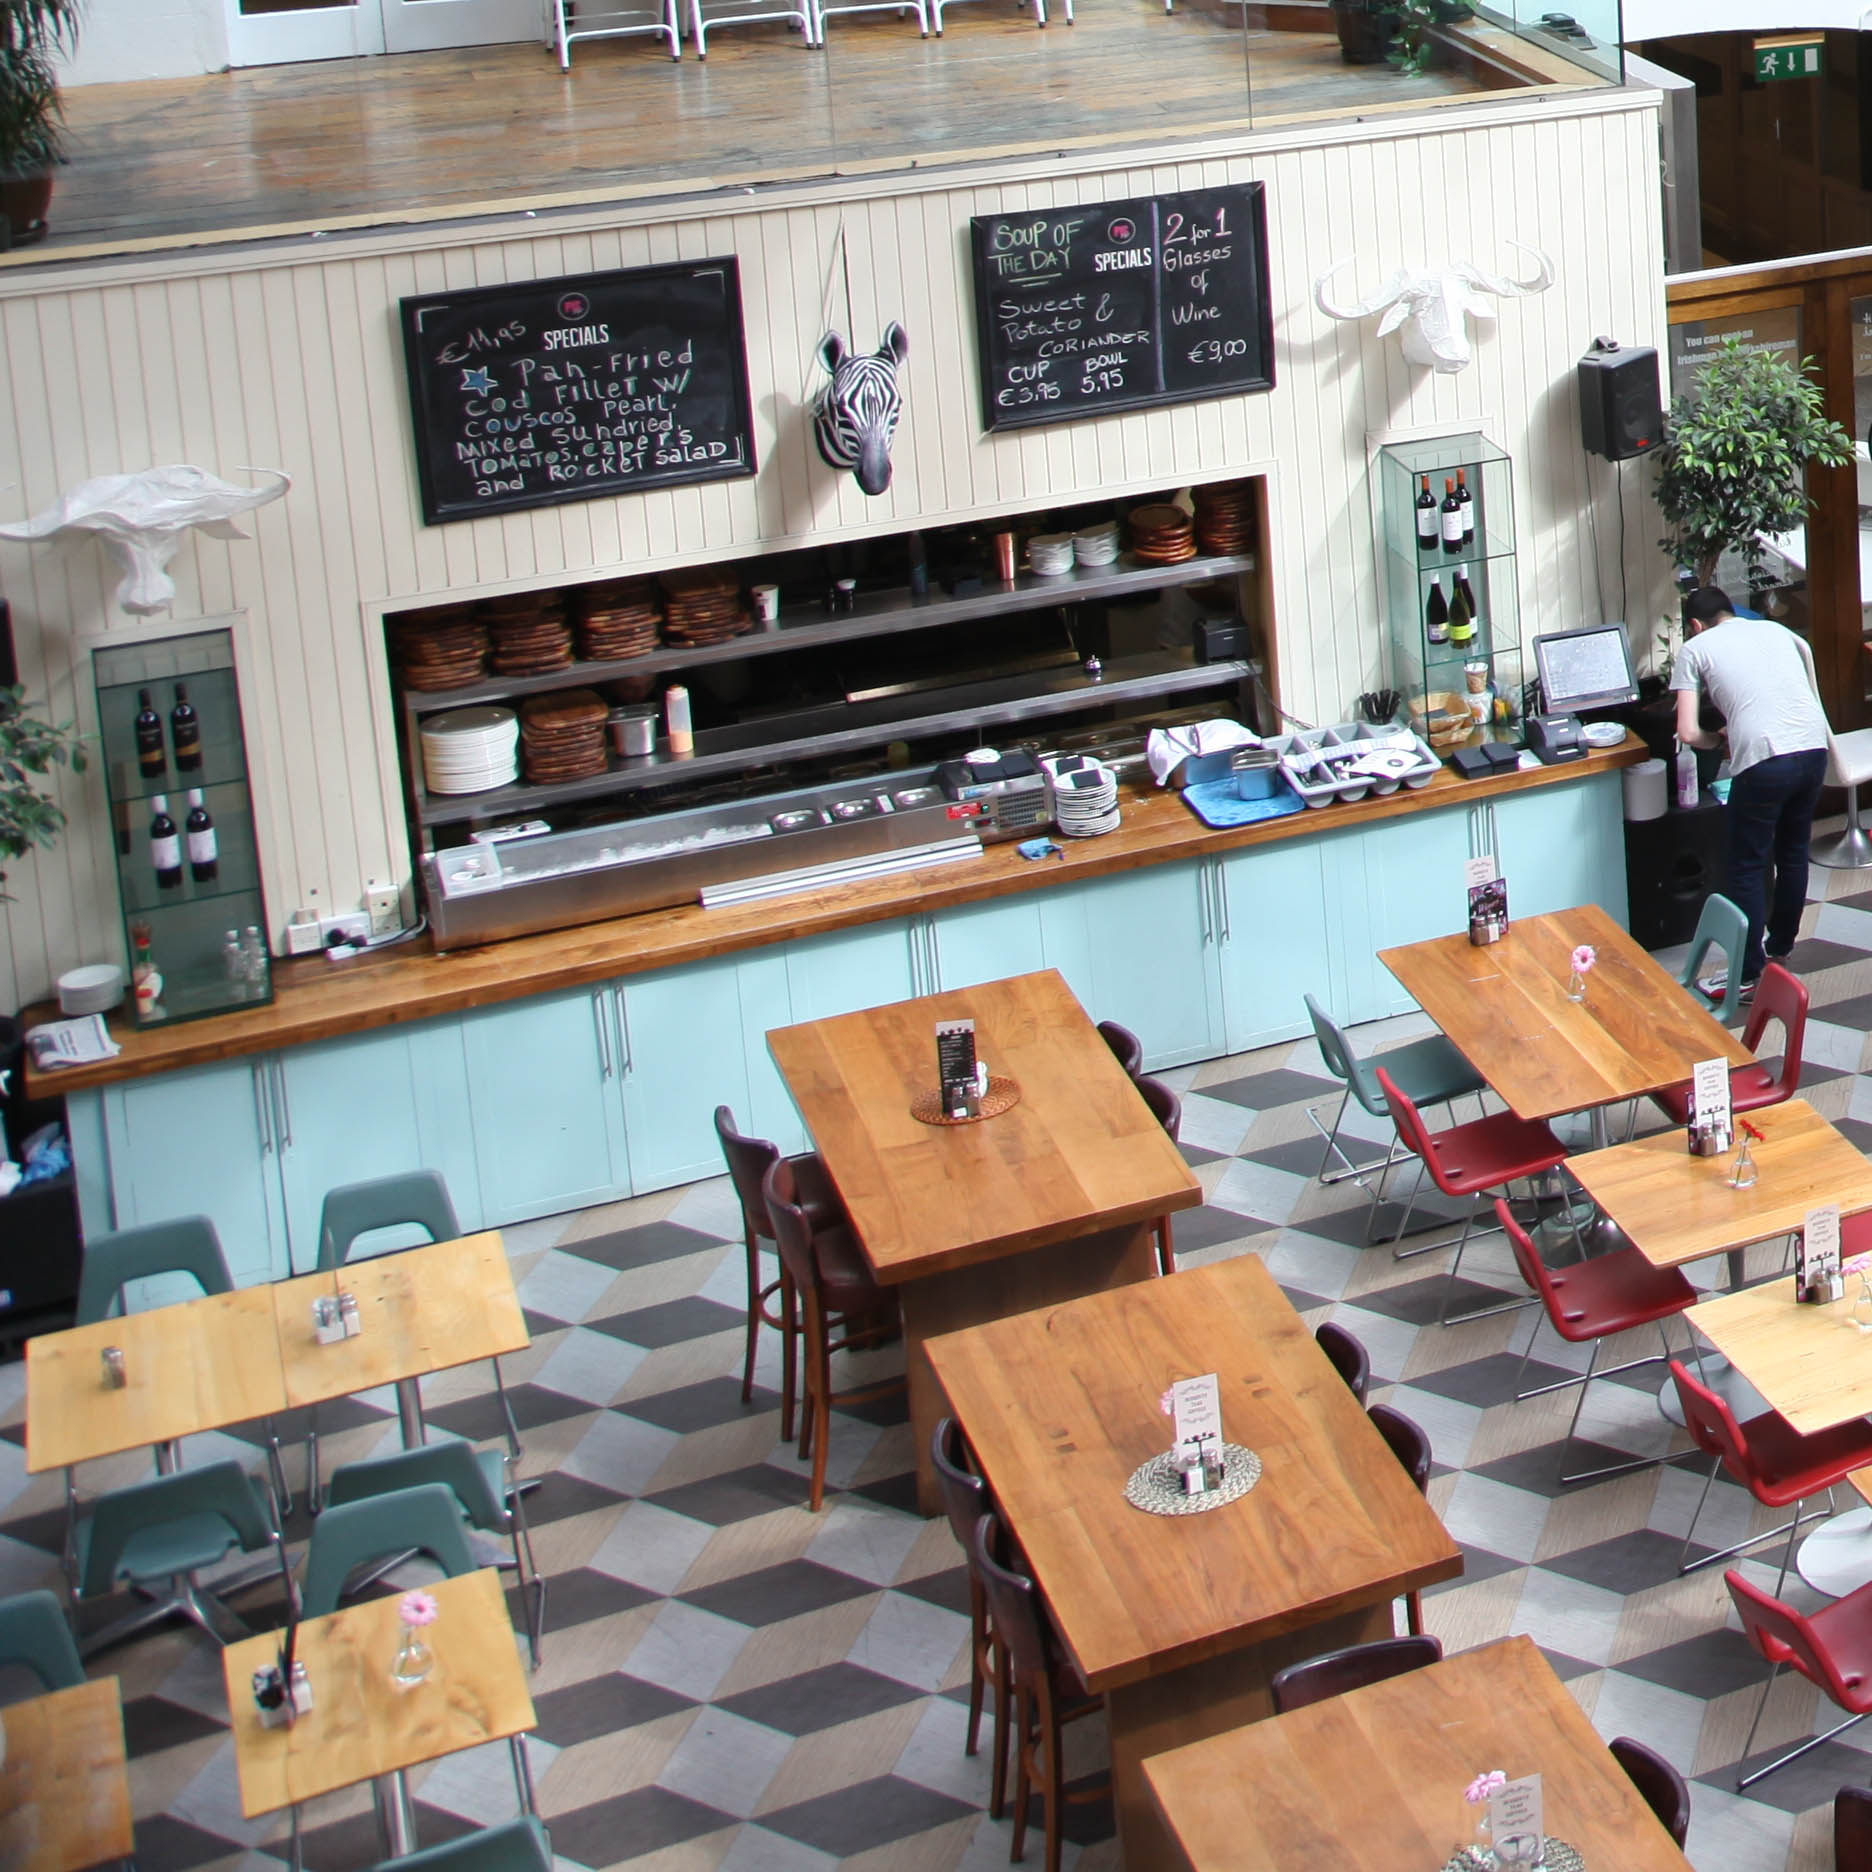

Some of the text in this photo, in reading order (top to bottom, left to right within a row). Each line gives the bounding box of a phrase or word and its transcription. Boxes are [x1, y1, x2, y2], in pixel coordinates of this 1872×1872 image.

[994, 220, 1047, 251] SOUP
[1053, 219, 1085, 247] OF
[1163, 212, 1187, 246] 2
[1191, 224, 1212, 246] for
[1213, 207, 1233, 238] 1
[988, 247, 1072, 277] THE DAY
[1095, 247, 1153, 273] SPECIALS
[1163, 244, 1232, 272] Glasses
[1191, 269, 1211, 296] of
[998, 293, 1115, 322] Sweet &
[1171, 302, 1223, 326] Wine
[544, 324, 609, 351] SPECIALS
[1001, 316, 1083, 345] Potato
[1008, 351, 1129, 384] CUP BOWL
[476, 473, 525, 497] and
